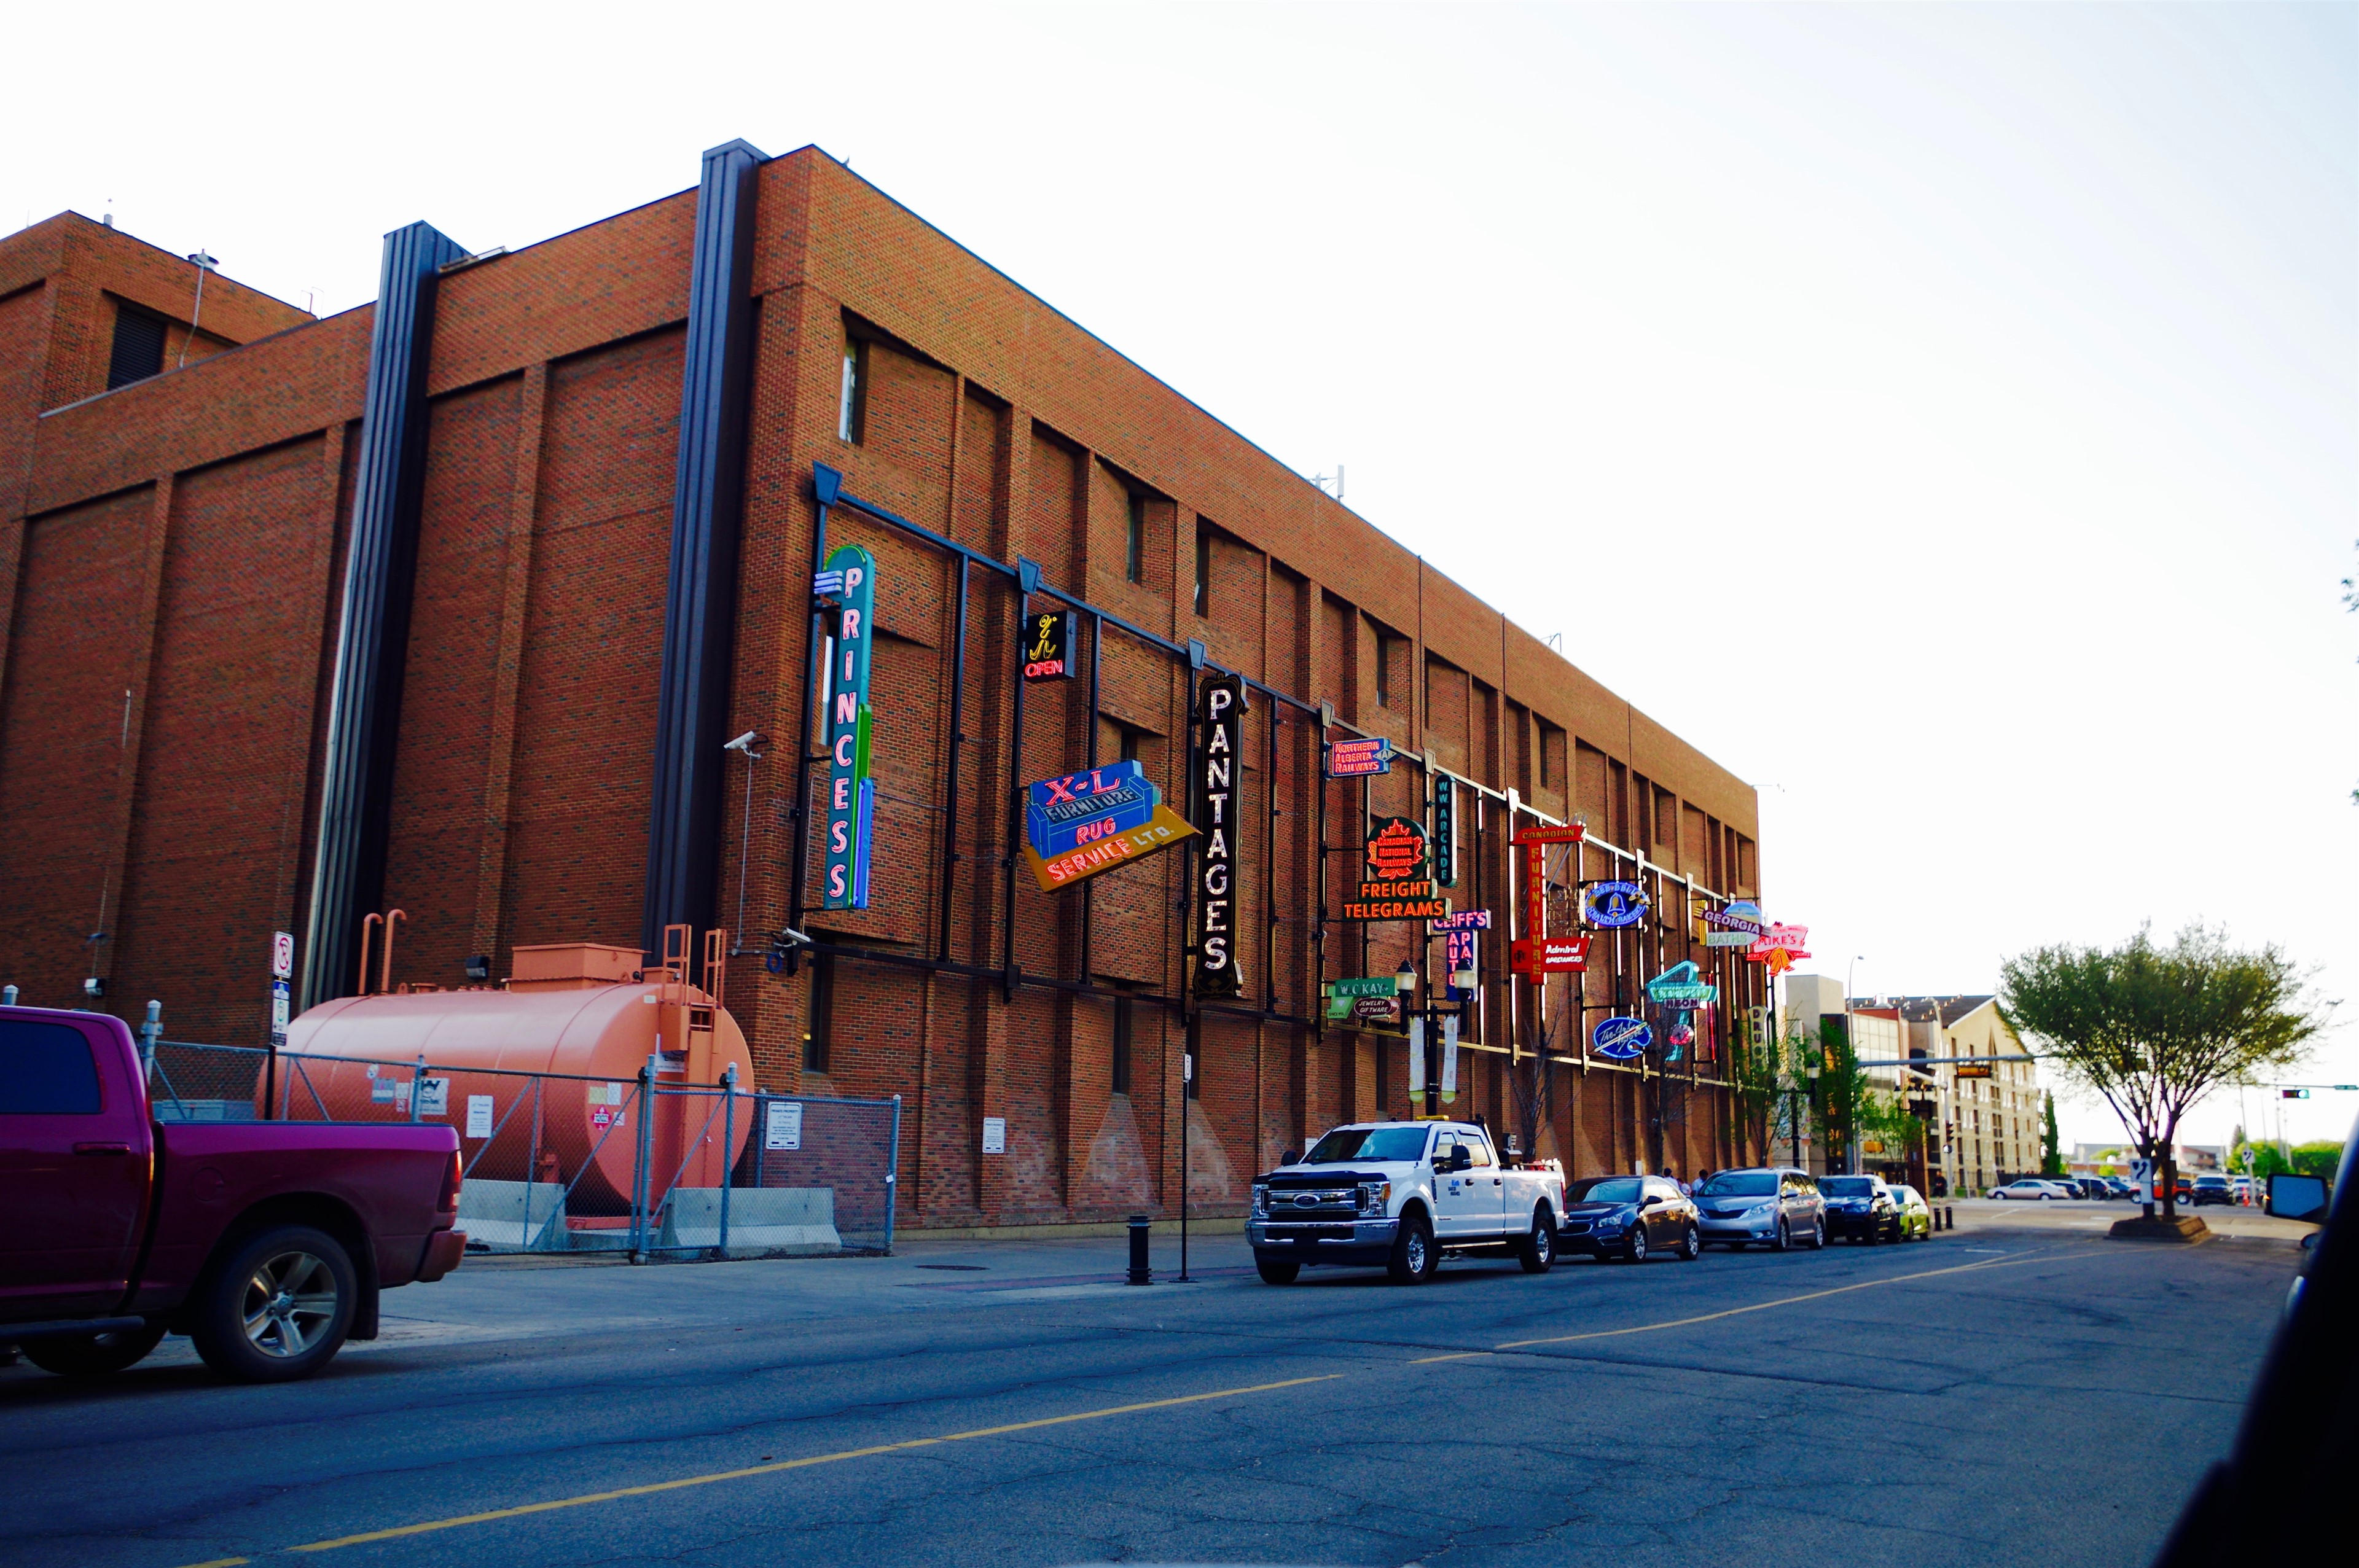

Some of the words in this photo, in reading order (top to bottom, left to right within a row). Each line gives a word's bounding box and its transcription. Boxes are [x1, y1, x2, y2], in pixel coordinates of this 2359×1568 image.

[1025, 660, 1063, 677] OPEN
[829, 567, 863, 898] PRINCESS
[1335, 741, 1379, 753] NORTHERN
[1335, 752, 1372, 763] ALBERTA
[1335, 762, 1379, 773] RAILWAYS
[1045, 770, 1121, 806] X-L
[1046, 788, 1136, 822] FURNITURE
[1076, 817, 1116, 845] RUG
[1205, 688, 1232, 970] PANTAGES
[1522, 829, 1575, 839] CANADIAN
[1377, 837, 1413, 846] CANADIAN
[1047, 838, 1134, 881] SERVICE
[1379, 848, 1412, 857] NATIONAL
[1377, 859, 1412, 867] RAILWAYS
[1361, 881, 1431, 898] FREIGHT
[1344, 901, 1444, 918] TELEGRAMS
[1531, 848, 1541, 975] FURNITURE
[1705, 911, 1760, 934] GEORGIA
[1708, 934, 1747, 944] BATHS
[1758, 934, 1797, 945] MIKE'S
[1546, 943, 1580, 953] Admiral
